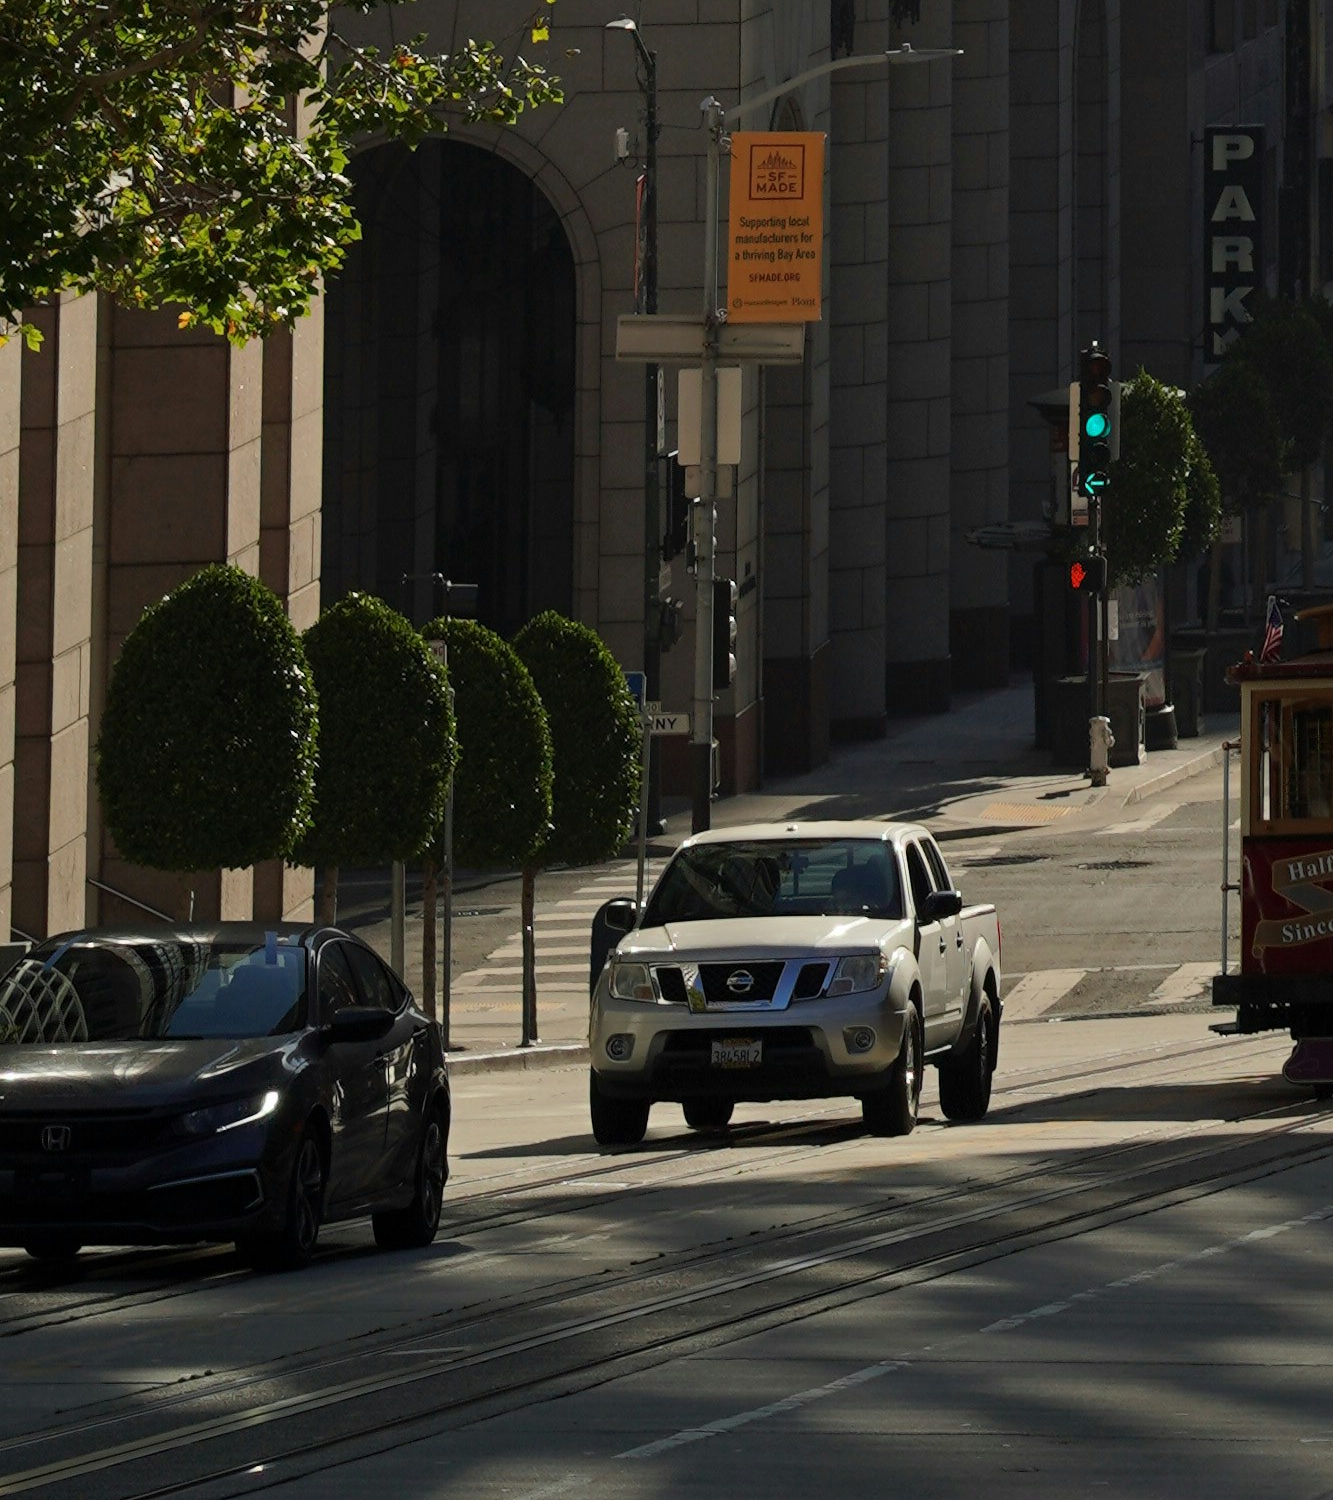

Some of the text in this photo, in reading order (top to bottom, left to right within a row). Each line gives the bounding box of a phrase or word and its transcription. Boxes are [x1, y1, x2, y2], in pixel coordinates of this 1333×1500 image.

[768, 171, 787, 182] SF
[756, 182, 797, 193] MADE
[739, 215, 810, 231] Supporting local
[735, 231, 814, 244] manufacturers for
[742, 249, 775, 263] thriving
[777, 248, 793, 262] Bay
[795, 248, 816, 260] Area
[748, 272, 800, 282] SFMADE.ORG
